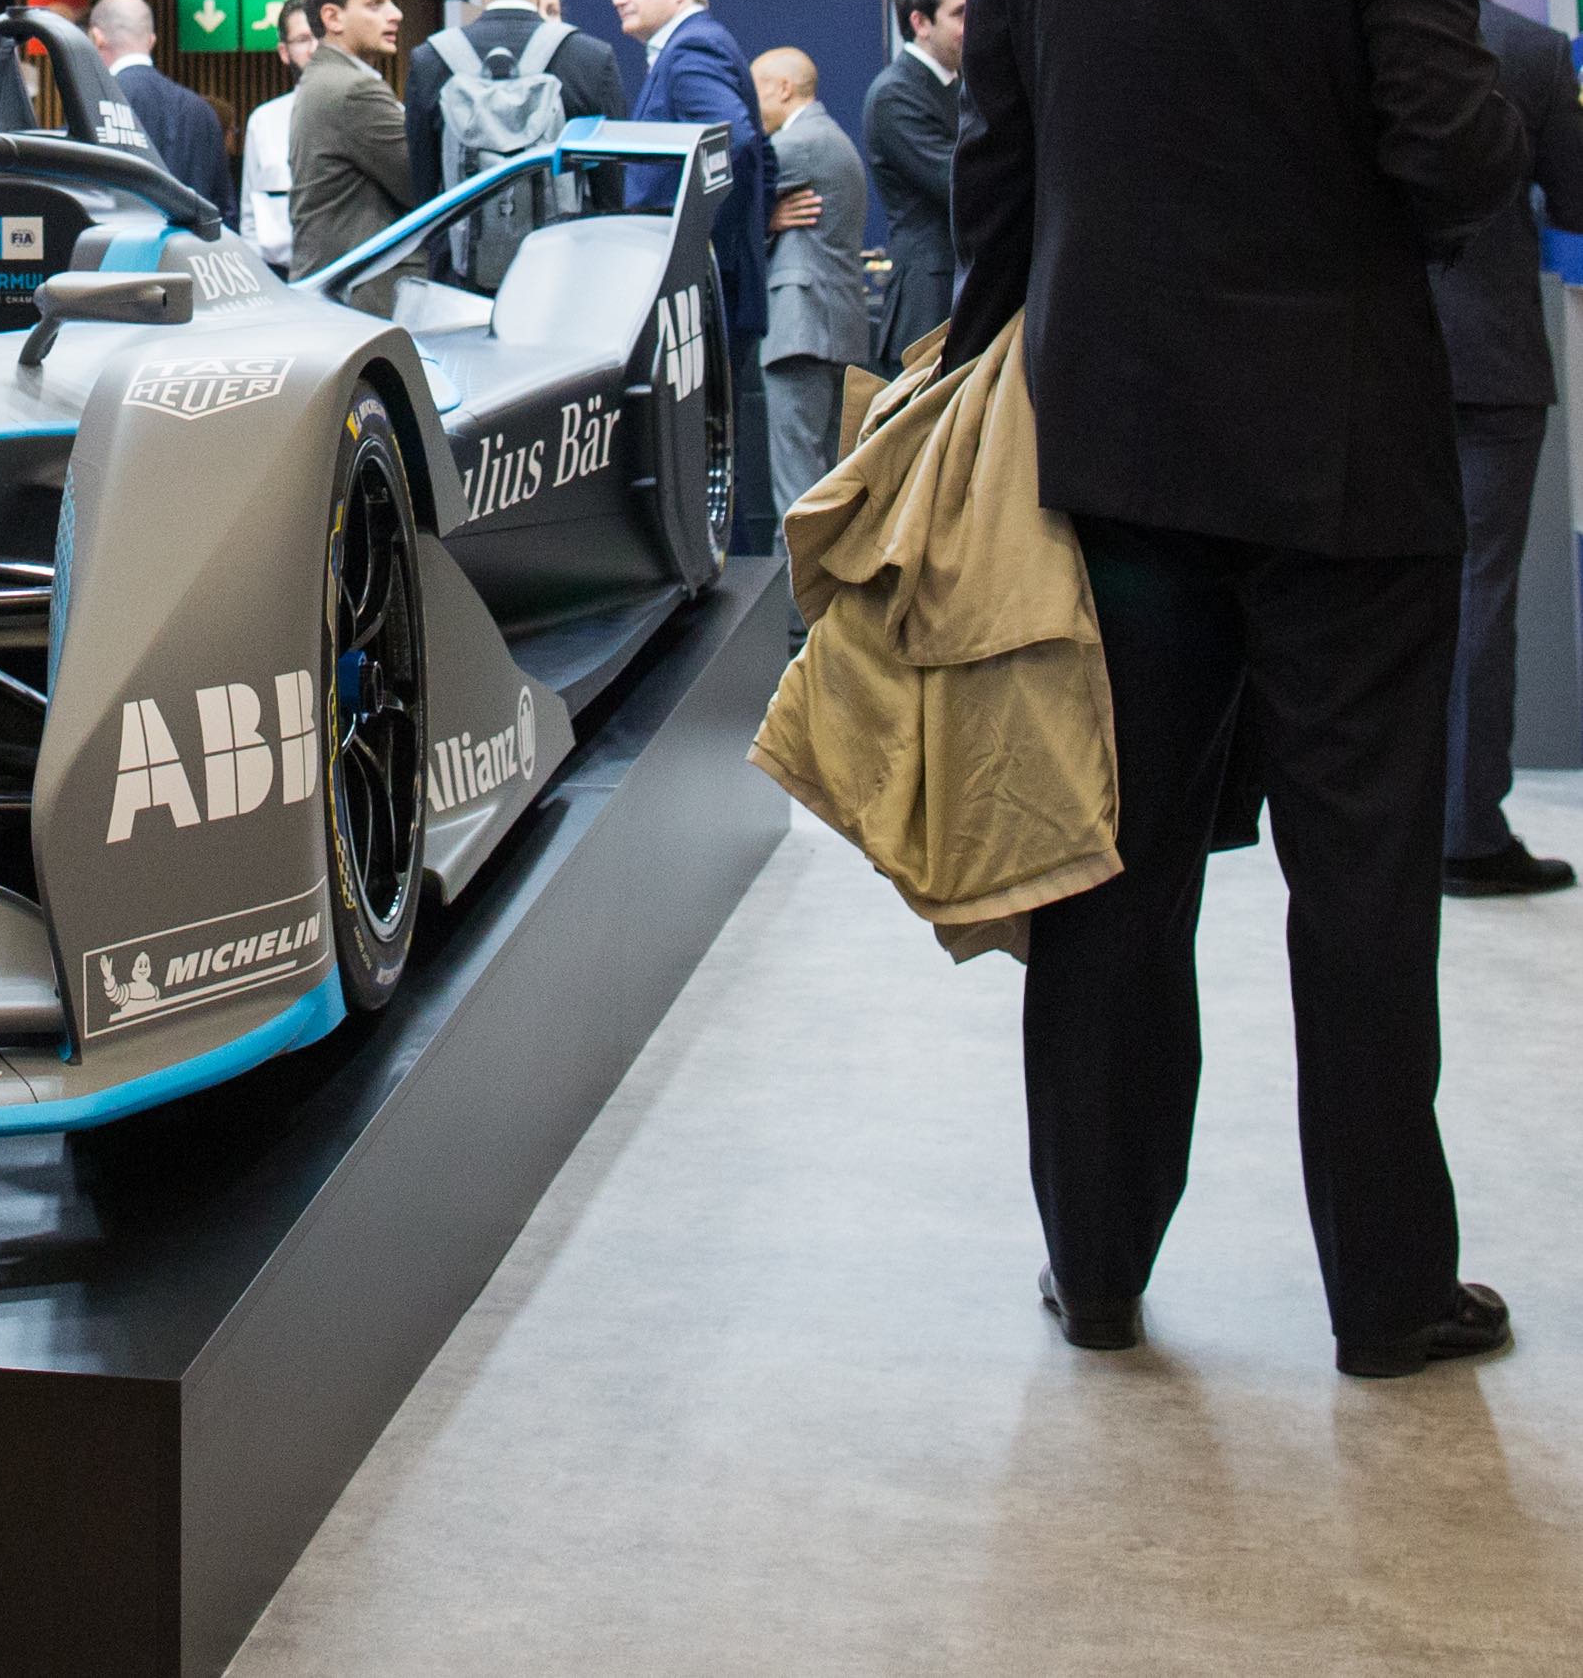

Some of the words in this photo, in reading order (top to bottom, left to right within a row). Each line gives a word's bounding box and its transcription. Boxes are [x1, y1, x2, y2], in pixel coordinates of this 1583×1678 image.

[187, 251, 260, 300] BOSS
[5, 295, 34, 304] CHAM
[150, 359, 275, 375] TAG
[134, 378, 274, 413] HEUER
[552, 394, 622, 488] Bär
[164, 912, 321, 988] MICHELIN
